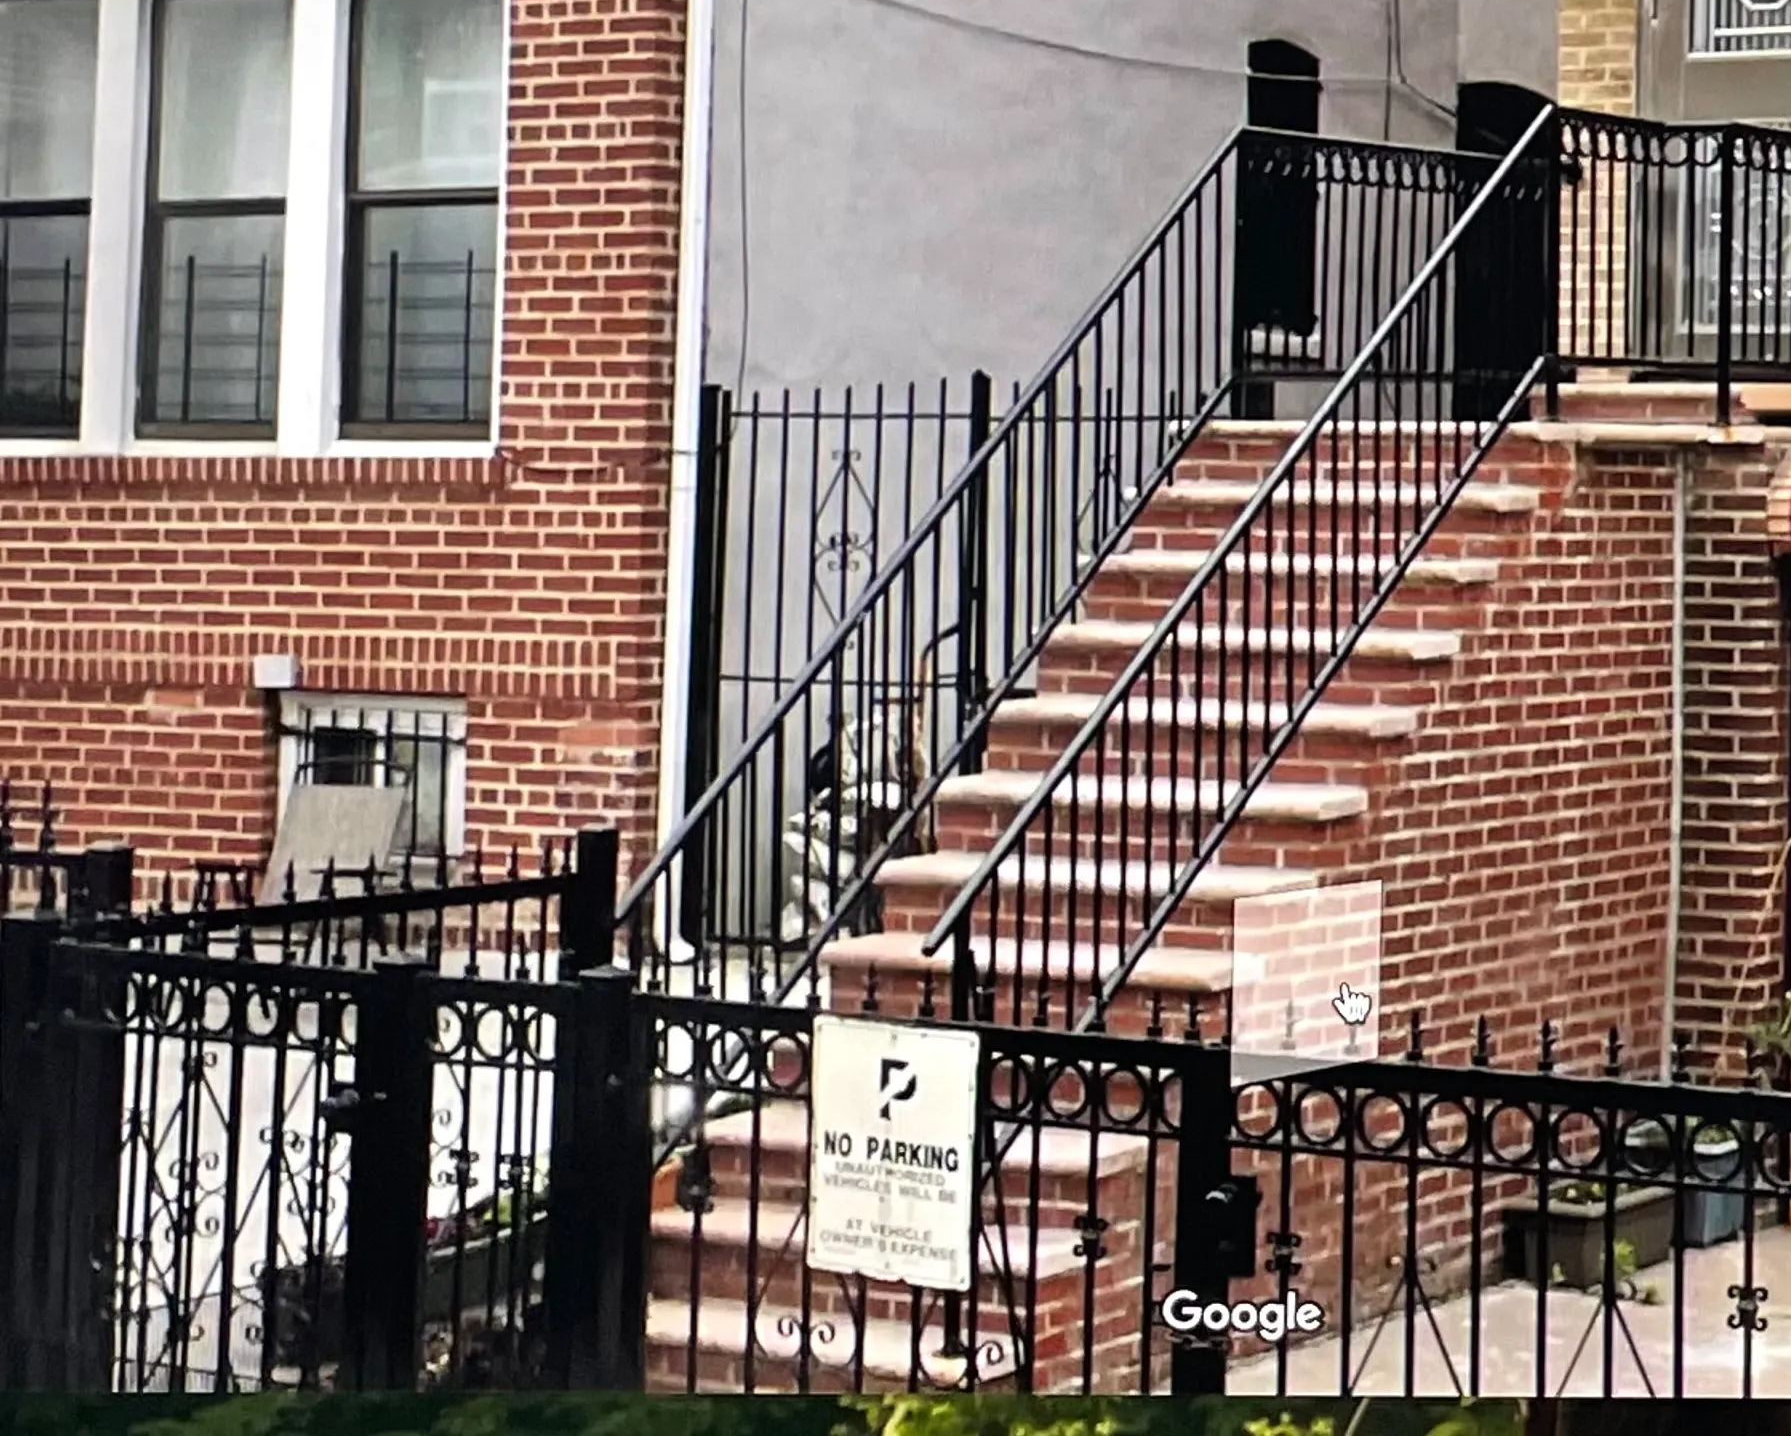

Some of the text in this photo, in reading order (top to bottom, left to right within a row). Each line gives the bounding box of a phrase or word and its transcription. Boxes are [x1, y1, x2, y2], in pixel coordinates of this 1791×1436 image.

[824, 1130, 959, 1172] NO PARKING
[824, 1173, 891, 1195] VEHICLES
[899, 1184, 932, 1201] WILL
[869, 1221, 933, 1244] VEHICLE
